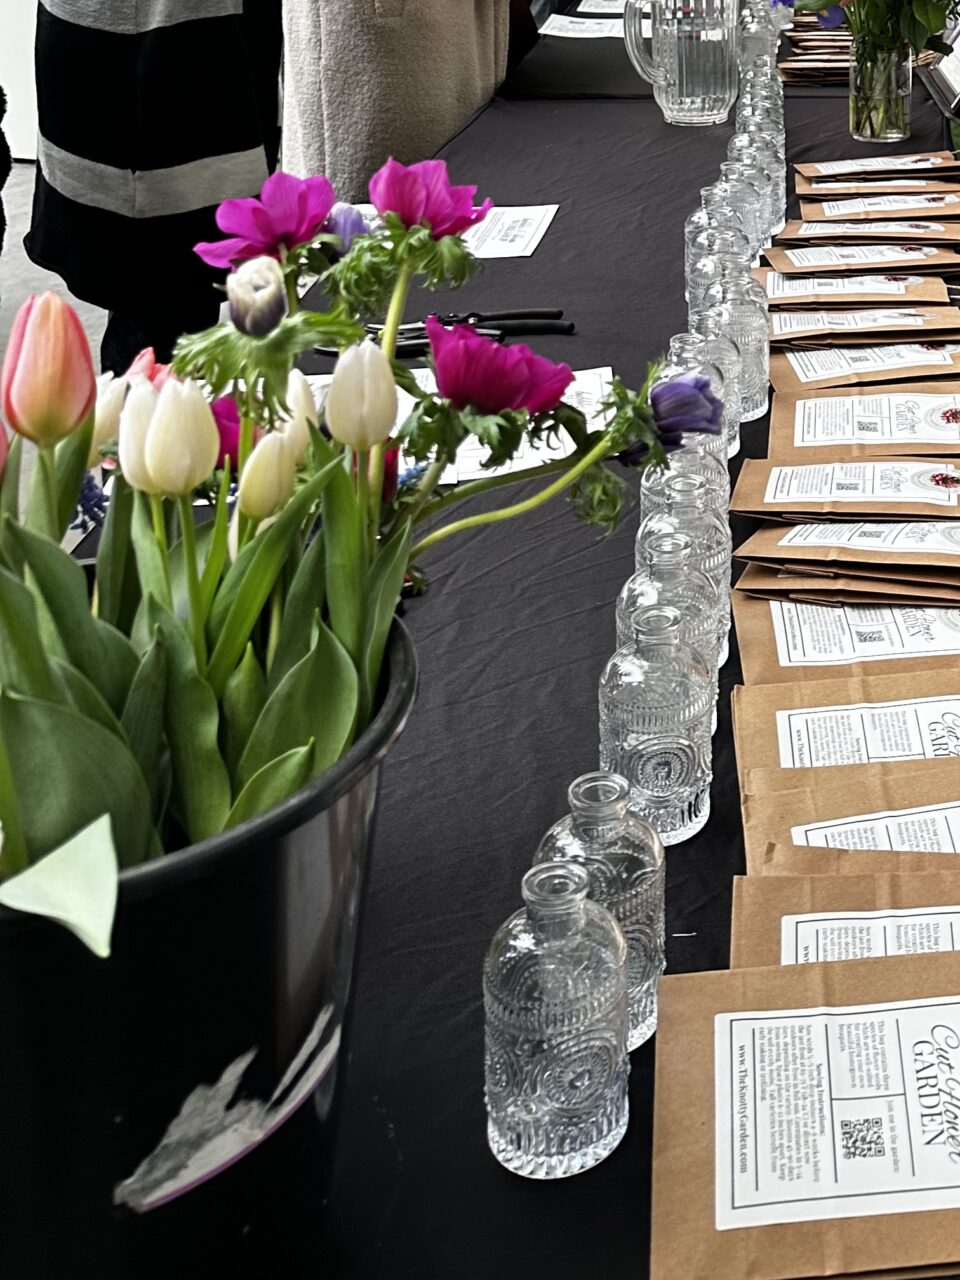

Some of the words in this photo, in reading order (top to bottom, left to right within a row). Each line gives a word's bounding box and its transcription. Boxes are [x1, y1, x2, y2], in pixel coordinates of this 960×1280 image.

[815, 1063, 823, 1088] Sowing
[930, 1024, 960, 1074] Cut
[738, 1044, 748, 1173] www.TheKnottyGarden.com
[911, 1039, 946, 1147] GARDEN
